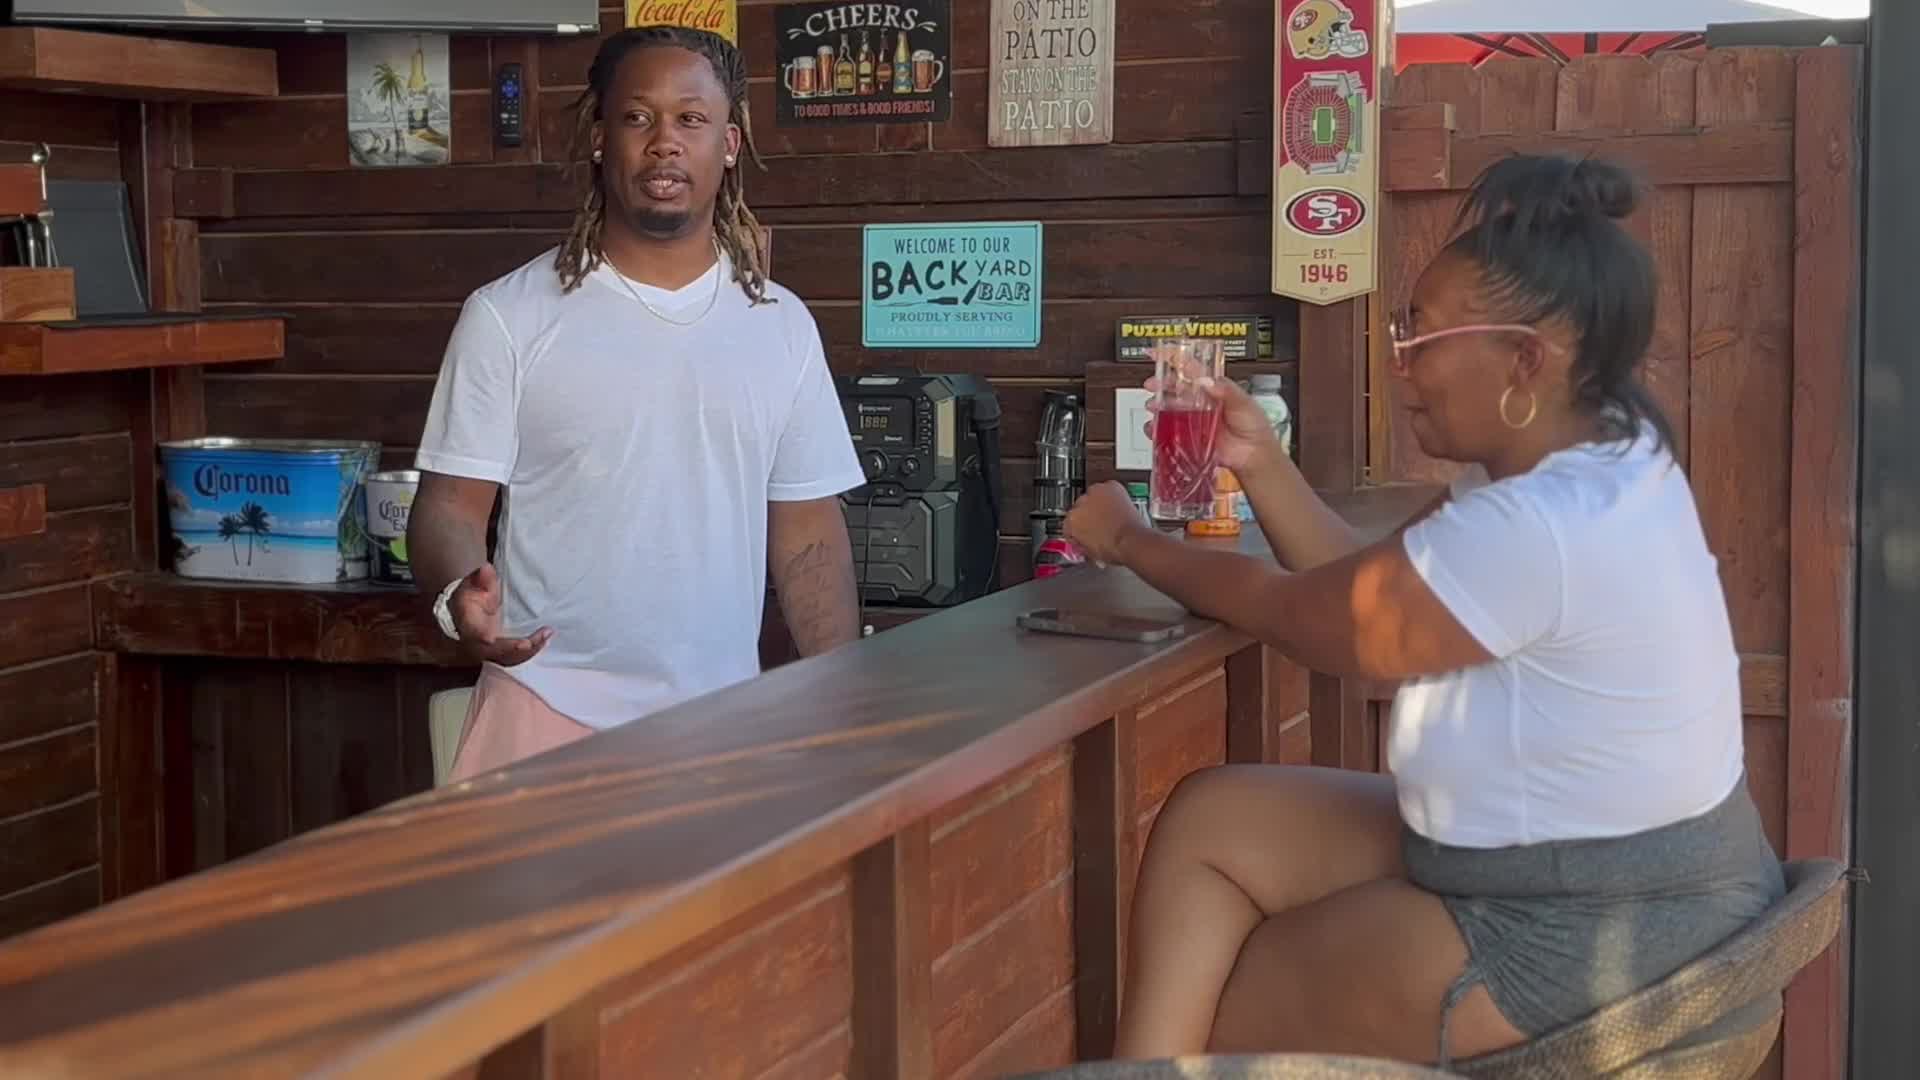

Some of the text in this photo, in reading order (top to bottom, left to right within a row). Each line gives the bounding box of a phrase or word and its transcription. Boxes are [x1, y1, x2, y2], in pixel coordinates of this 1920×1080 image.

[805, 3, 919, 36] CHEERS
[1013, 0, 1089, 22] ON THE
[1004, 27, 1097, 60] PATIO
[1001, 65, 1097, 94] STAYS ON THE
[794, 104, 806, 118] TO
[806, 103, 832, 117] GOOD
[832, 103, 859, 116] TIMES
[867, 101, 892, 115] GOOD
[1004, 99, 1094, 131] PATIO
[894, 237, 1011, 255] WELCOME TO OUR
[1313, 248, 1337, 260] EST.
[871, 259, 1032, 301] BACK YARD
[1299, 263, 1349, 284] 1946
[977, 282, 1032, 302] BAR
[890, 311, 1013, 324] PROUDLY SERVING
[1121, 322, 1245, 338] PUZZLE VISION
[193, 463, 291, 500] Corona
[377, 497, 409, 523] Cor
